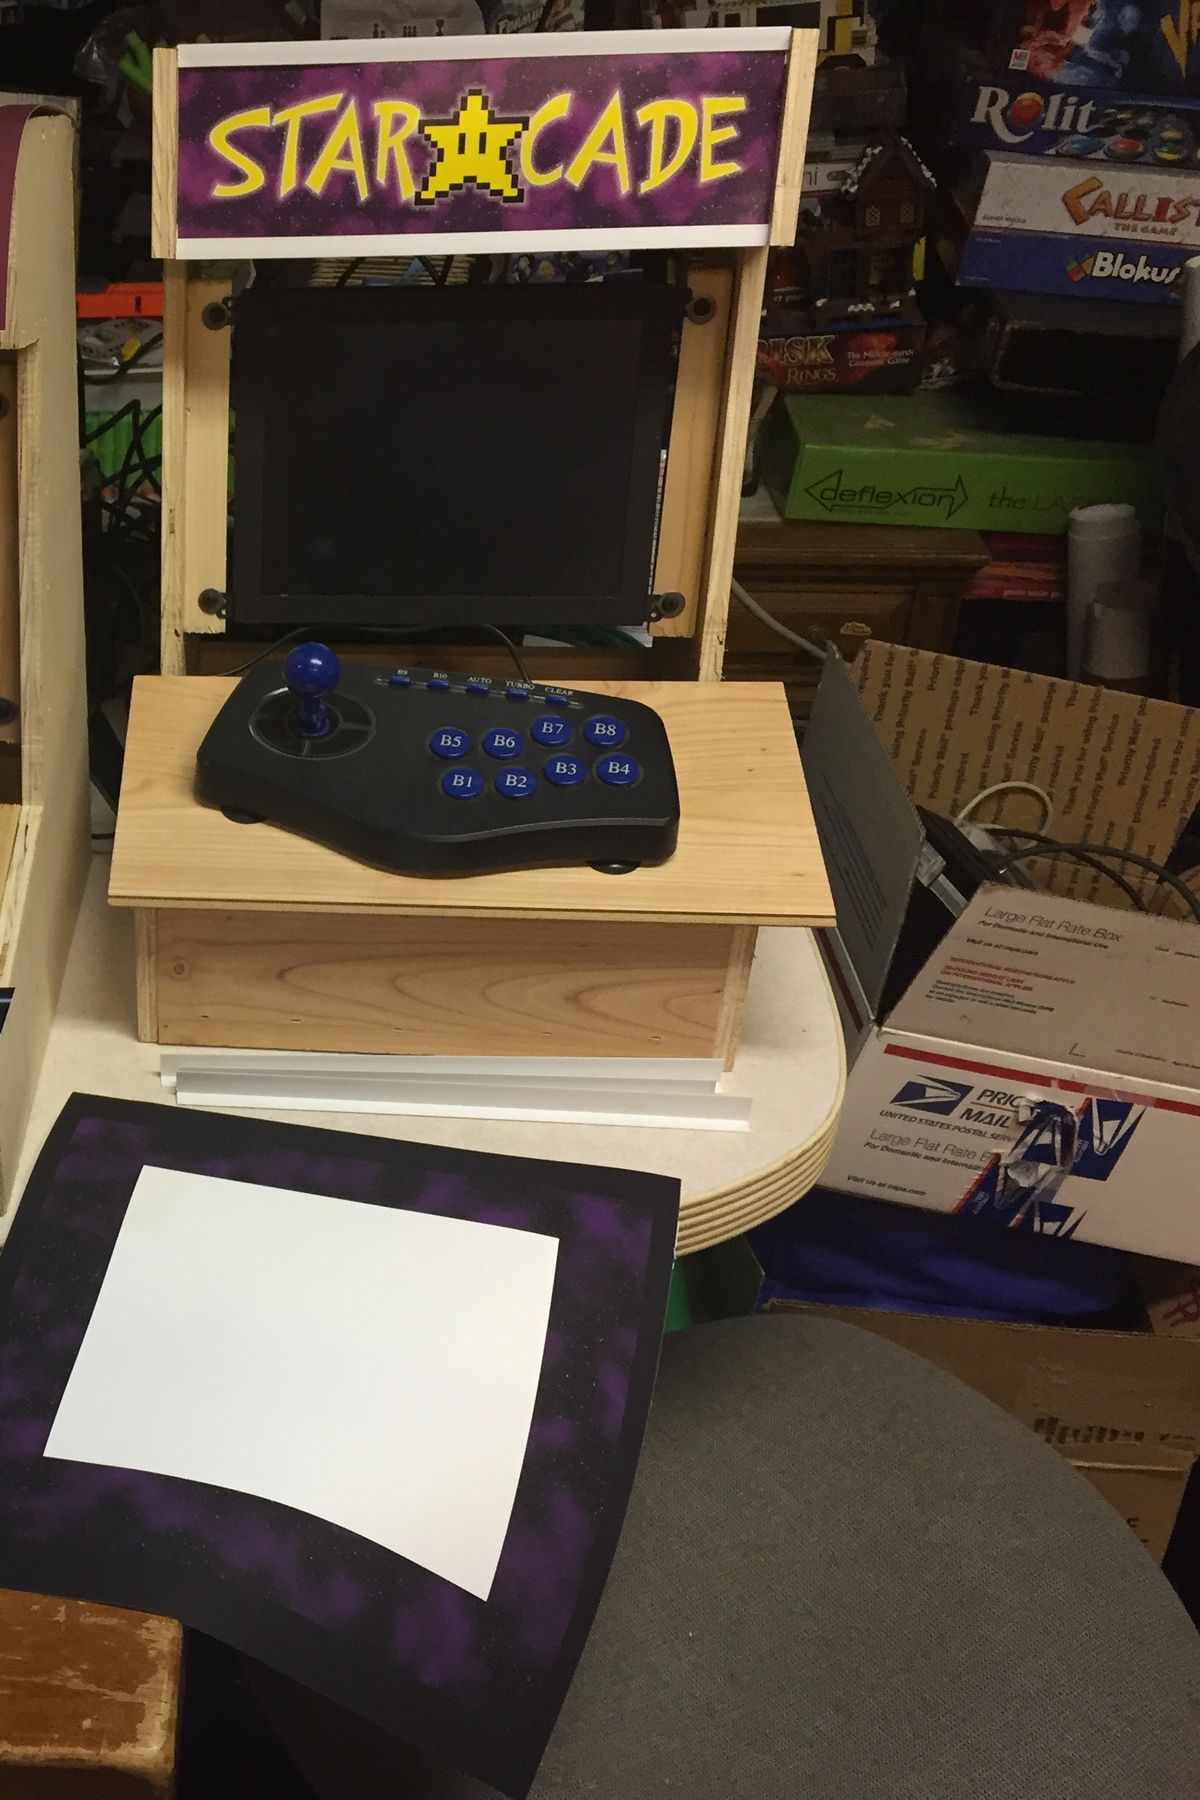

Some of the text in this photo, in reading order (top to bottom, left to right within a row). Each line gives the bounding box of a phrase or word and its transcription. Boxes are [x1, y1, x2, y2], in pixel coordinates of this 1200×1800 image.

[970, 86, 1104, 144] Rolit
[1091, 252, 1182, 284] Blokus
[816, 477, 958, 513] deflexion
[989, 486, 1026, 511] the
[467, 676, 492, 684] AUTO
[505, 681, 535, 690] TURBO
[544, 686, 575, 696] CLEAR
[542, 722, 563, 735] B7
[595, 723, 617, 736] B8
[440, 735, 462, 748] B5
[493, 735, 516, 748] B6
[555, 762, 577, 775] B3
[608, 761, 630, 775] B4
[452, 775, 473, 788] B1
[505, 775, 528, 788] B2
[984, 907, 1123, 942] Large Flat Rate Box
[879, 1109, 918, 1123] UNITED
[918, 1117, 950, 1131] STATES
[950, 1125, 987, 1138] POSTAL
[959, 1108, 1011, 1129] MAIL
[864, 1141, 880, 1150] For
[870, 1128, 911, 1146] Large
[914, 1137, 940, 1152] Flat
[943, 1143, 976, 1159] Rate
